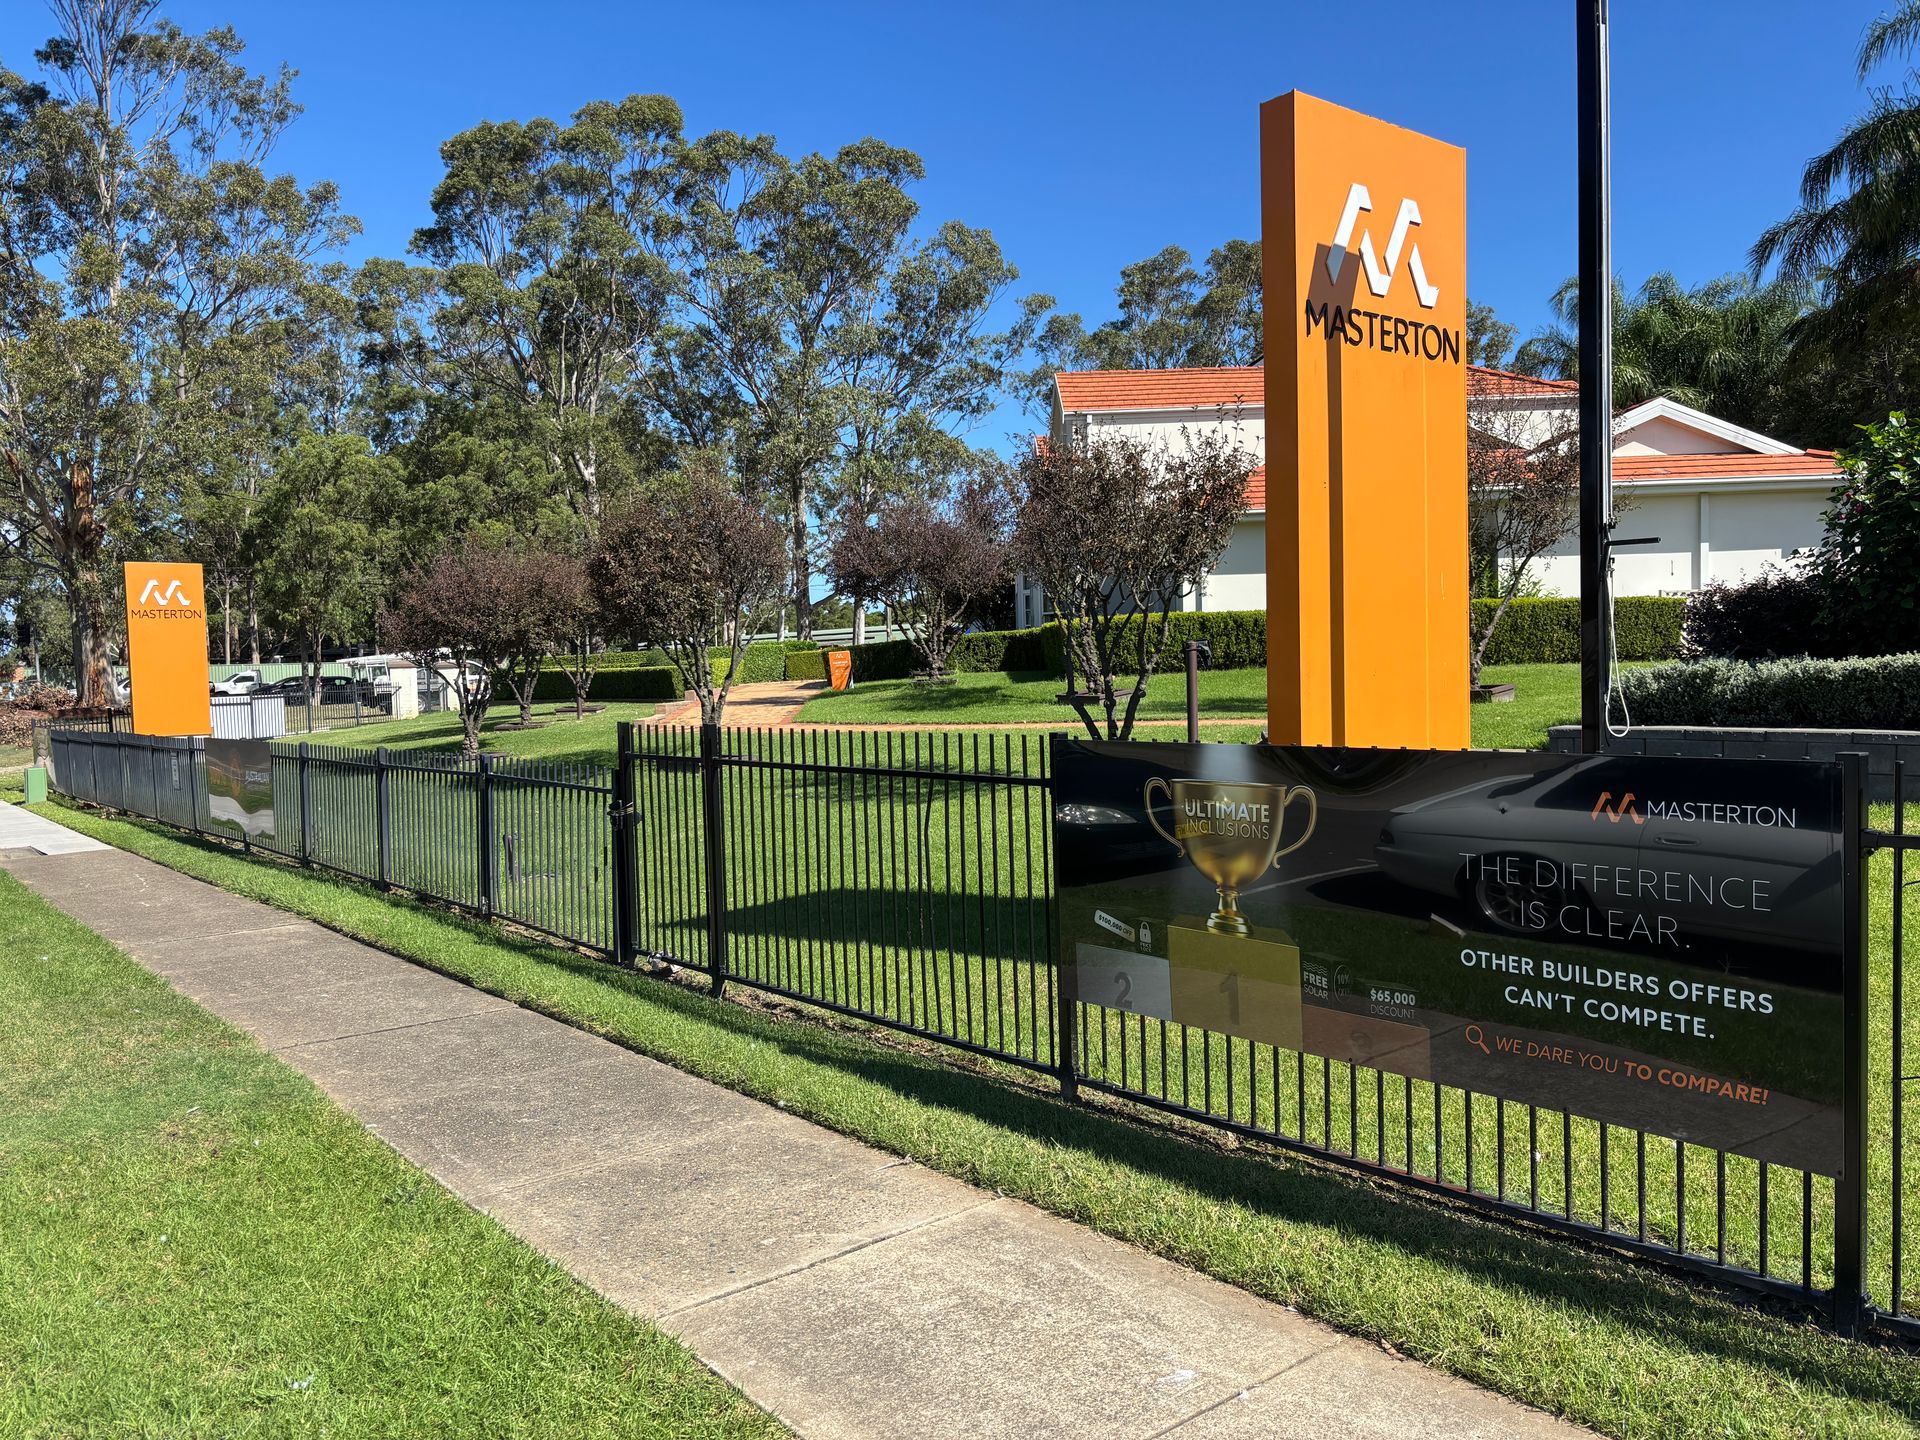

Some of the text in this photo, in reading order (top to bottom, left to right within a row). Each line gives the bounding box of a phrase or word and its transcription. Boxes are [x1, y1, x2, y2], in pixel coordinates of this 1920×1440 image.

[1305, 299, 1459, 364] MASTERTON
[131, 609, 202, 619] MASTERTON
[1184, 798, 1270, 823] ULTIMATE
[1647, 800, 1796, 828] MASTERTON
[1186, 818, 1270, 840] INCLUSIONS
[1458, 852, 1771, 912] THE DIFFERENCE
[1521, 900, 1690, 949] IS CLEAR.
[1113, 971, 1133, 1010] 2
[1303, 970, 1328, 989] FREE
[1303, 983, 1329, 1001] SOLAR
[1460, 949, 1774, 1015] OTHER BUILDERS OFFERS
[1219, 971, 1240, 1025] 1
[1370, 987, 1416, 1006] $65,000
[1370, 1004, 1416, 1019] DISCOUNT
[1504, 985, 1715, 1039] CAN'T COMPETE.
[1496, 1035, 1769, 1106] WE DARE YOU TO COMPARE!
